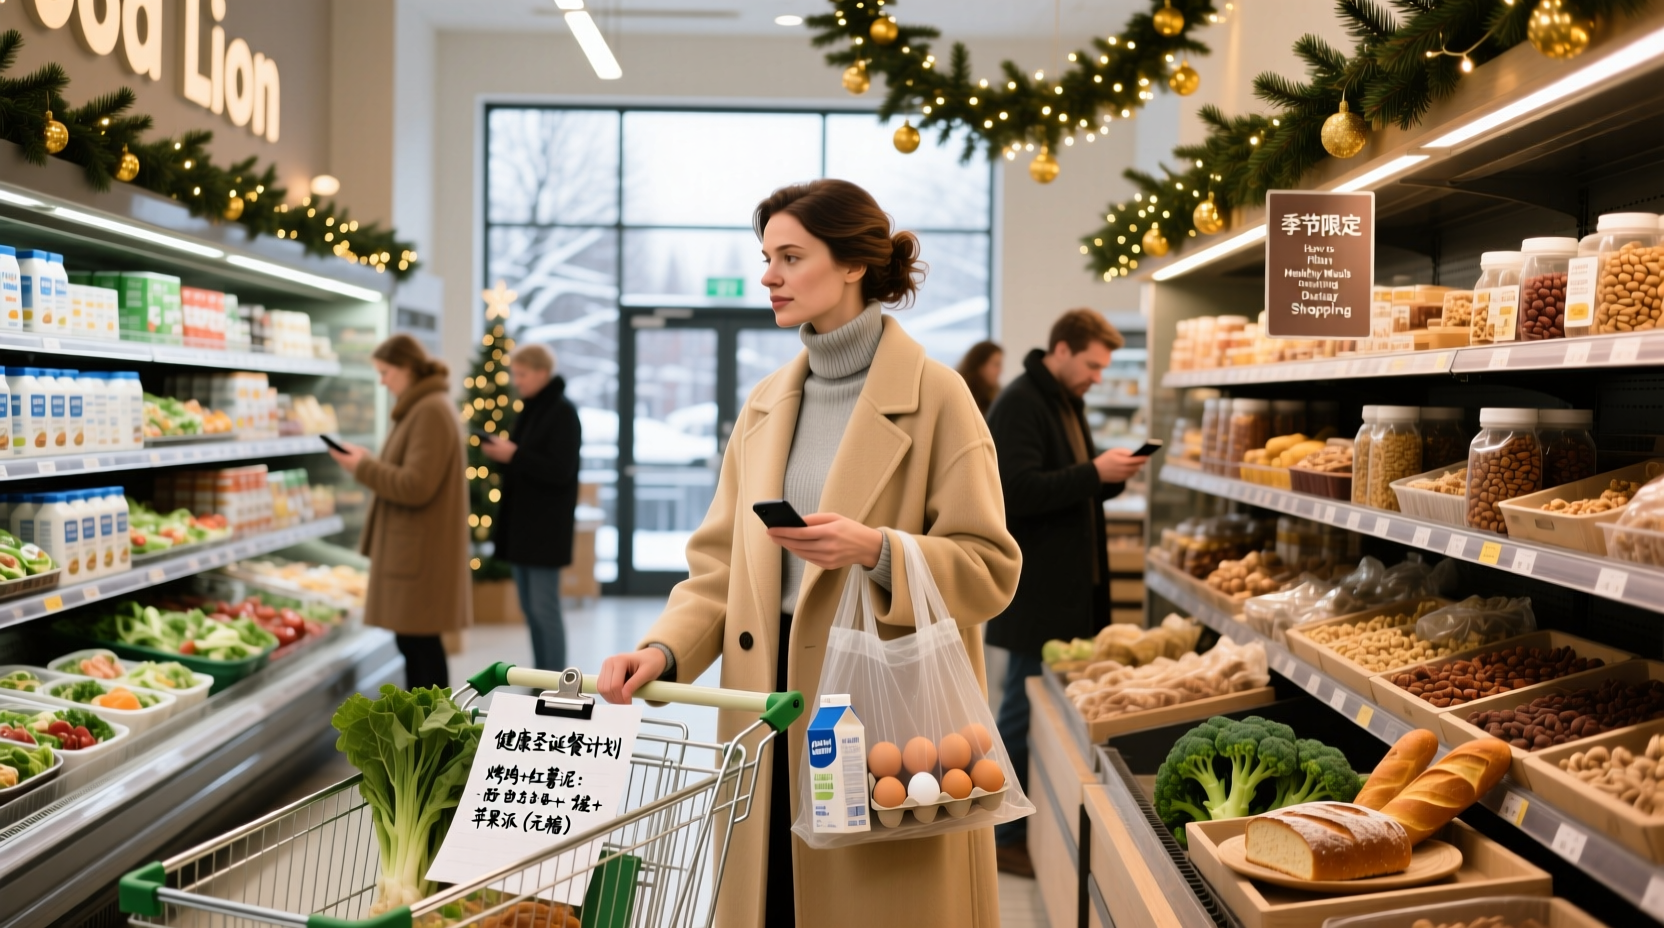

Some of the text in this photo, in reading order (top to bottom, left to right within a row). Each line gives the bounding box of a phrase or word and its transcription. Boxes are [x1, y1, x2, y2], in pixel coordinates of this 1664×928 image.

[184, 0, 280, 143] Lion
[1281, 212, 1362, 237] 季节限定
